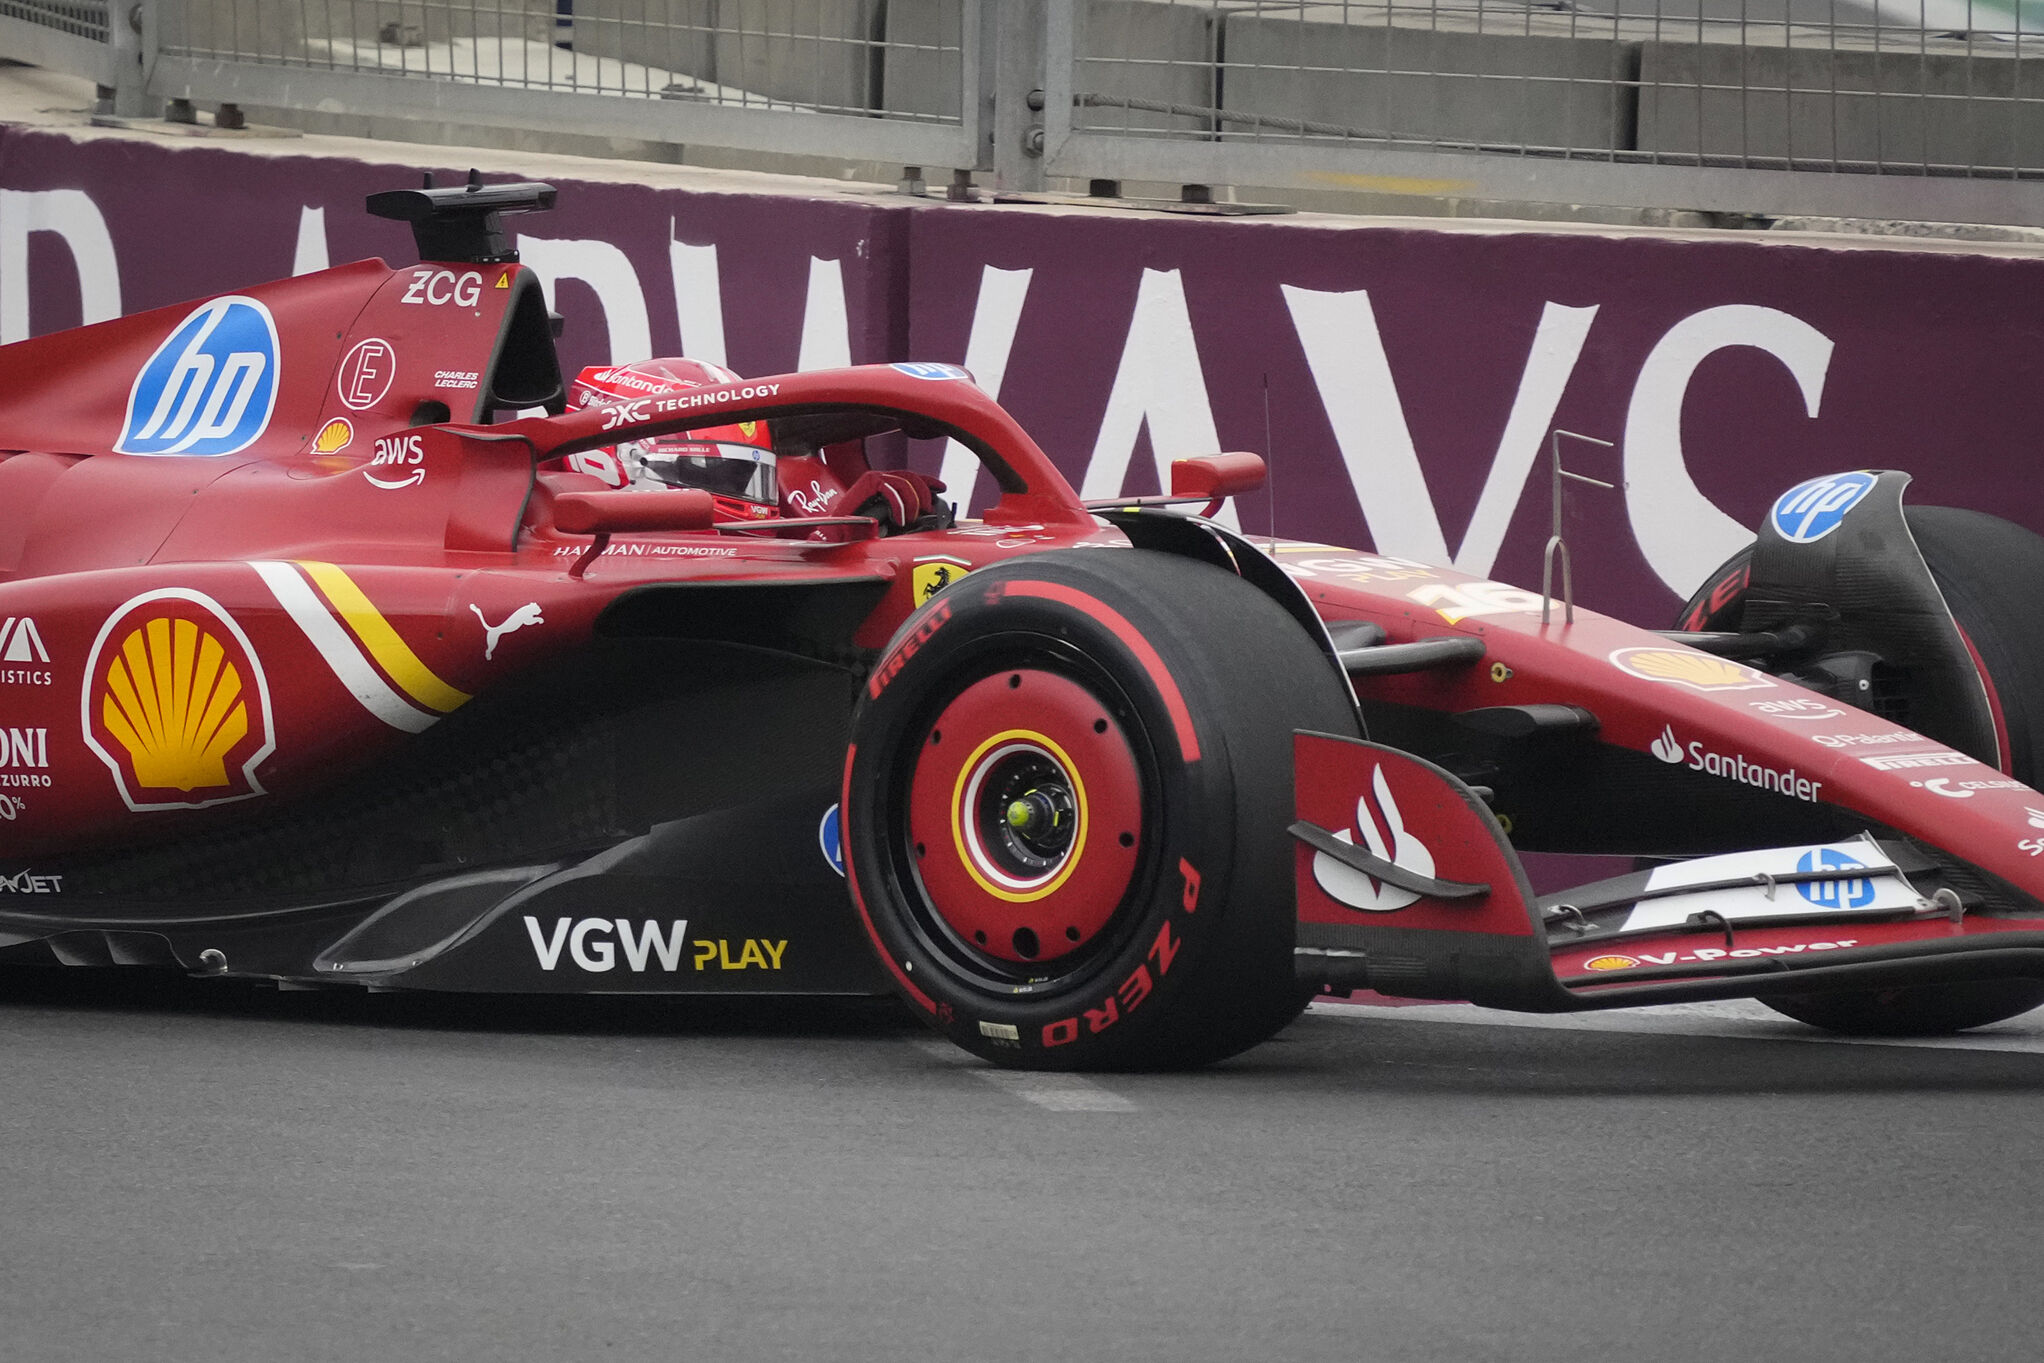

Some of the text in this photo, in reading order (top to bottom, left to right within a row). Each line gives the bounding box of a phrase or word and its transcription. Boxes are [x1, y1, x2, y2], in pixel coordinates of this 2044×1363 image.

[434, 371, 479, 380] CHARLES
[435, 379, 477, 389] LECLERC
[656, 384, 780, 412] TECHNOLOGY
[371, 435, 423, 467] aws
[1781, 472, 1866, 540] hp
[651, 547, 737, 556] AUTOMOTIVE
[1689, 741, 1822, 803] Santander
[523, 916, 788, 973] VGW PLAY
[1042, 857, 1201, 1048] P ZERO
[1638, 939, 1858, 965] V-Power
